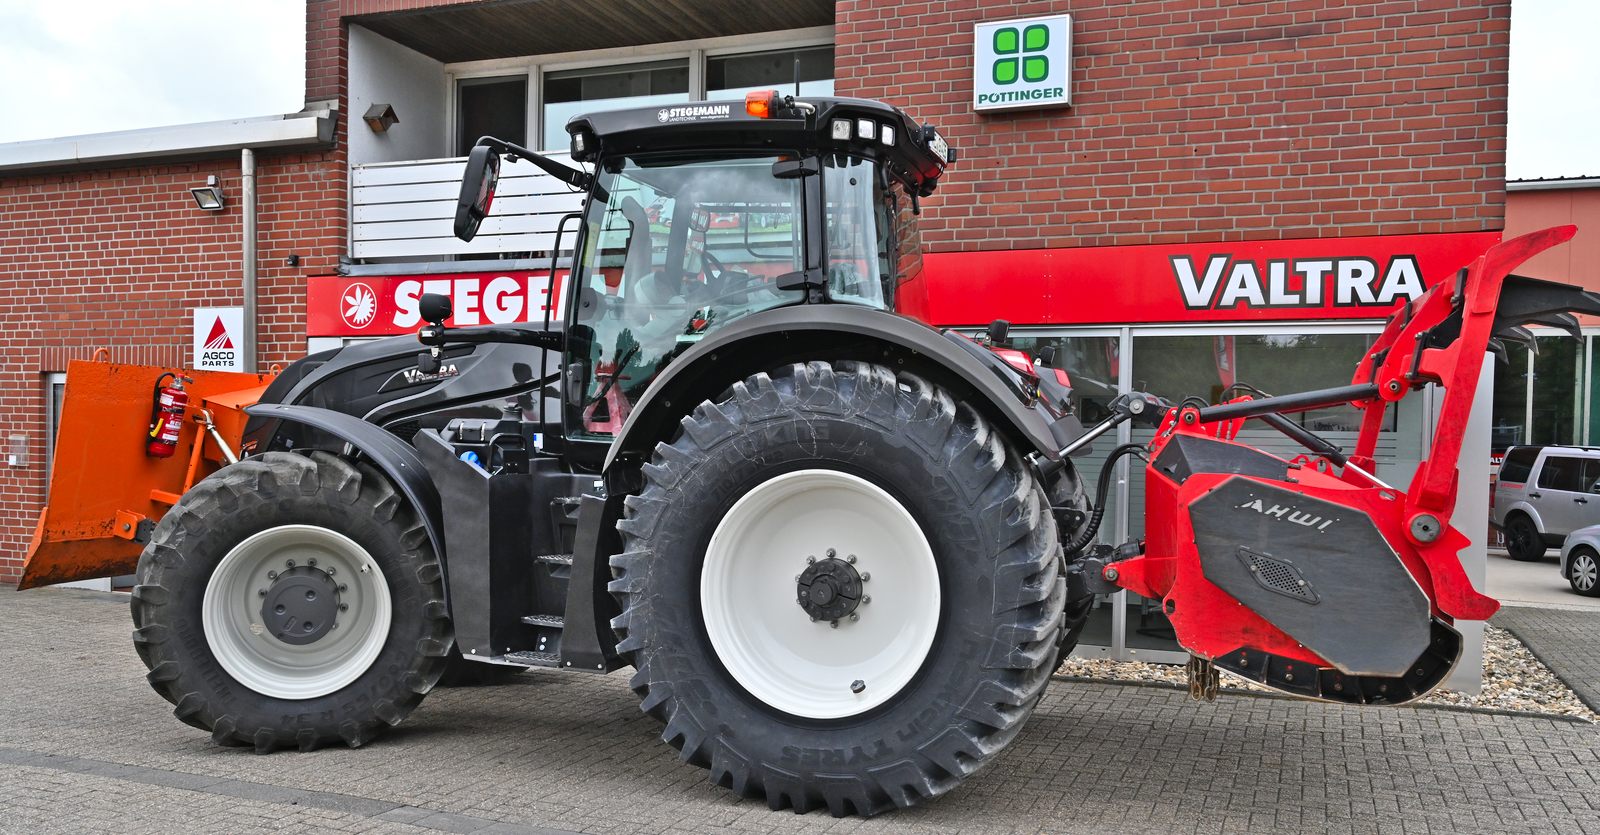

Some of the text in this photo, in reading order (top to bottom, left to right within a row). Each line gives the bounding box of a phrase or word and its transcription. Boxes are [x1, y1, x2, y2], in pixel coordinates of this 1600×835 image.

[669, 105, 730, 118] STEGEMANN
[1168, 254, 1428, 310] VALTRA
[392, 275, 571, 328] STEGE
[202, 351, 235, 360] AGCO
[403, 363, 459, 384] VARA
